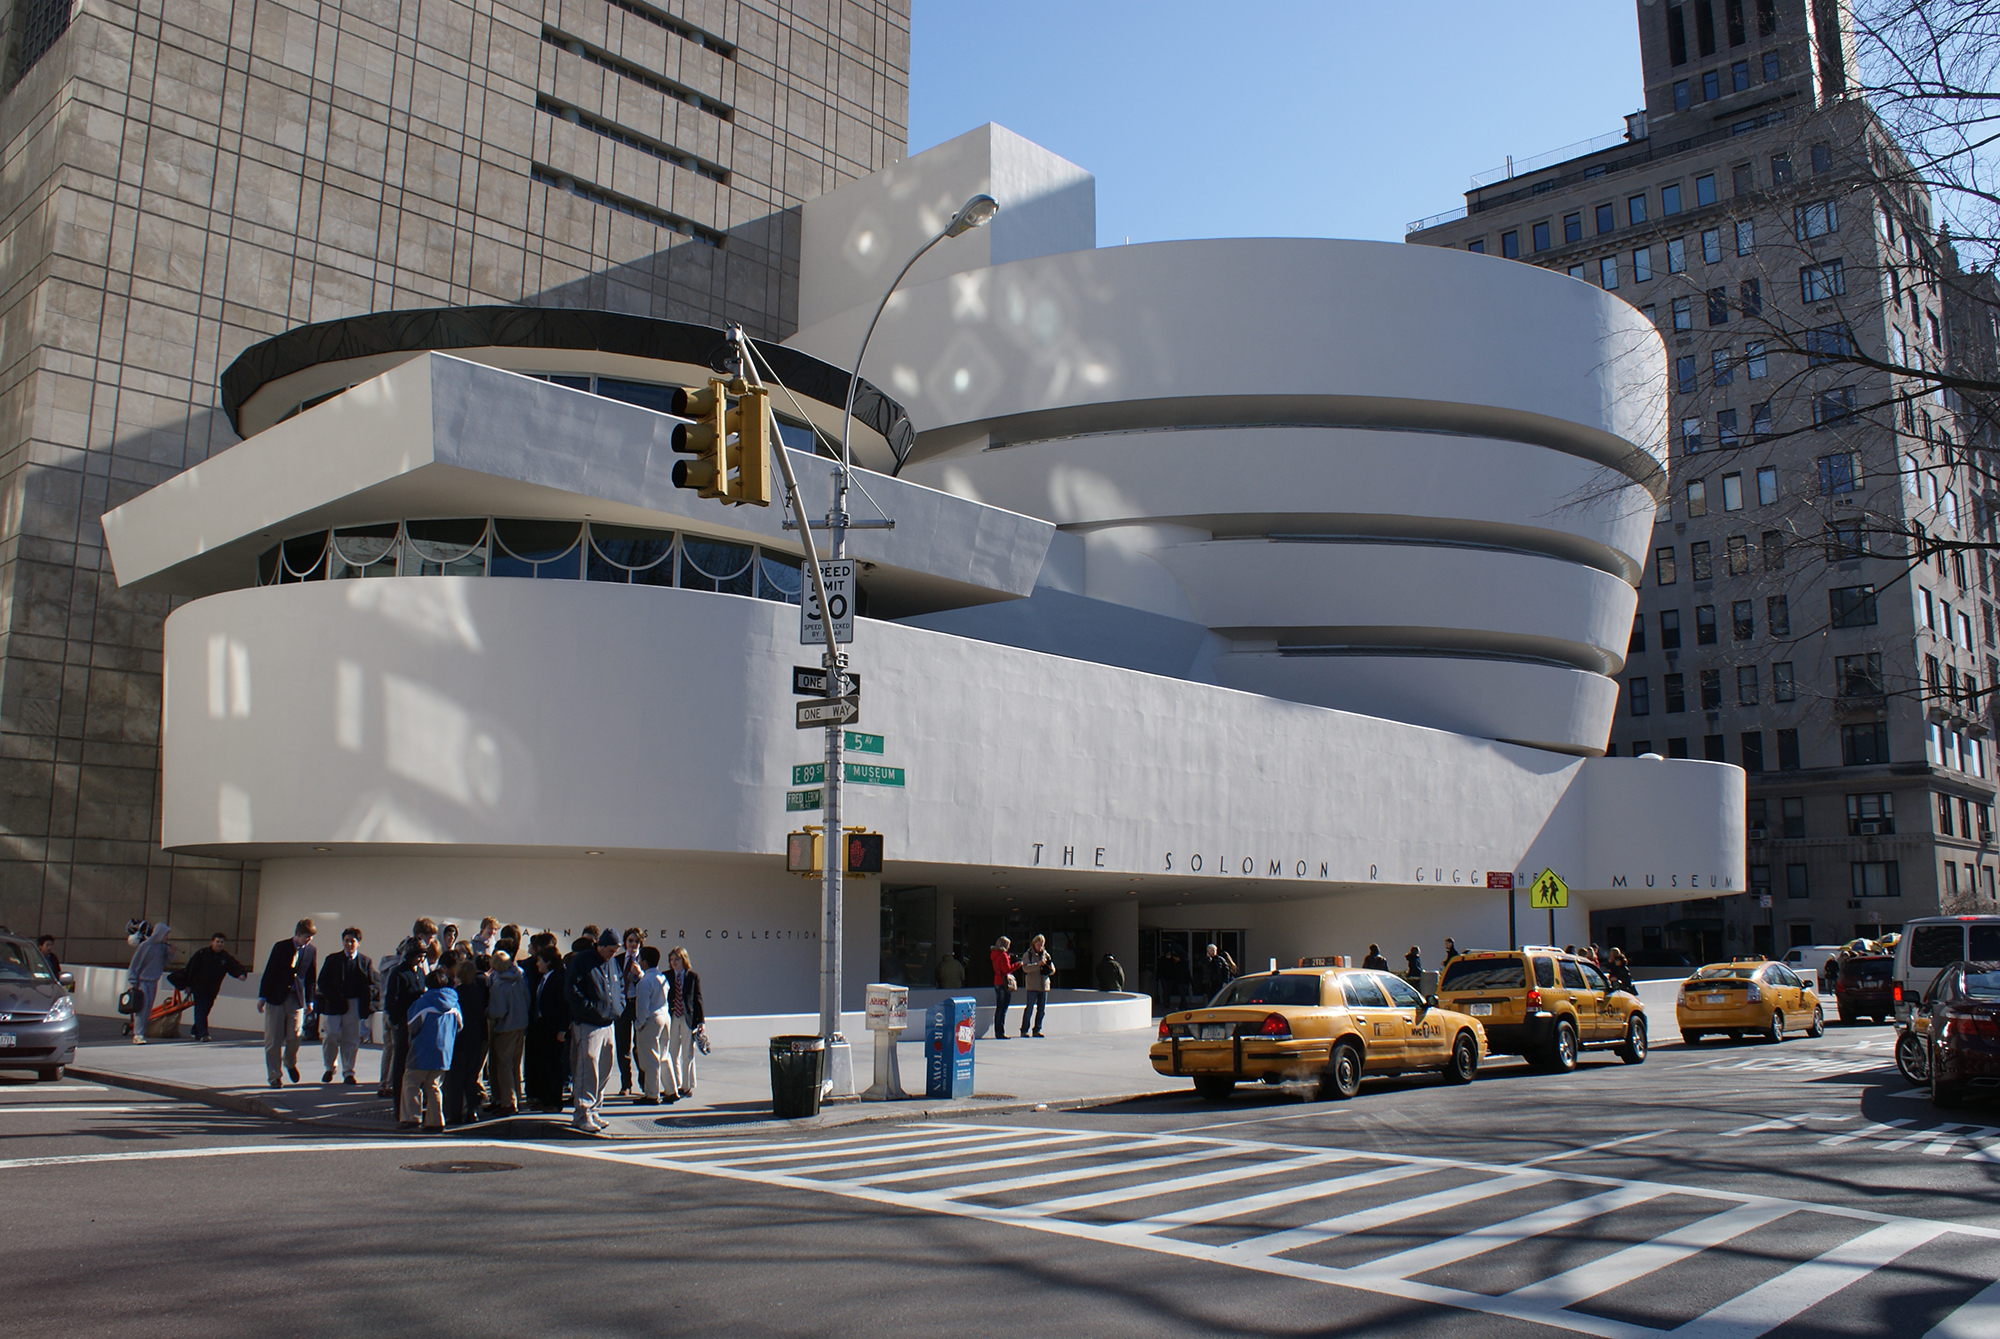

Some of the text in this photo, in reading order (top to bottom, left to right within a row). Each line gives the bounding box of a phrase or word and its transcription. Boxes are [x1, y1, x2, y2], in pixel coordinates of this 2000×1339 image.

[811, 580, 845, 592] LMIT
[806, 594, 848, 621] 30
[803, 675, 822, 688] ONE
[804, 704, 851, 720] ONE WAY
[854, 734, 874, 750] 5 AV
[795, 764, 823, 783] E 89 ST
[853, 765, 895, 780] MUSEUM
[787, 793, 804, 804] FRED
[1032, 843, 1106, 867] THE
[1165, 851, 1329, 878] SOLOMON
[1370, 863, 1378, 880] R
[1612, 874, 1733, 888] MUSEUM
[705, 929, 817, 940] COLLECTION
[934, 1012, 944, 1040] OUR
[933, 1052, 943, 1091] TOWN
